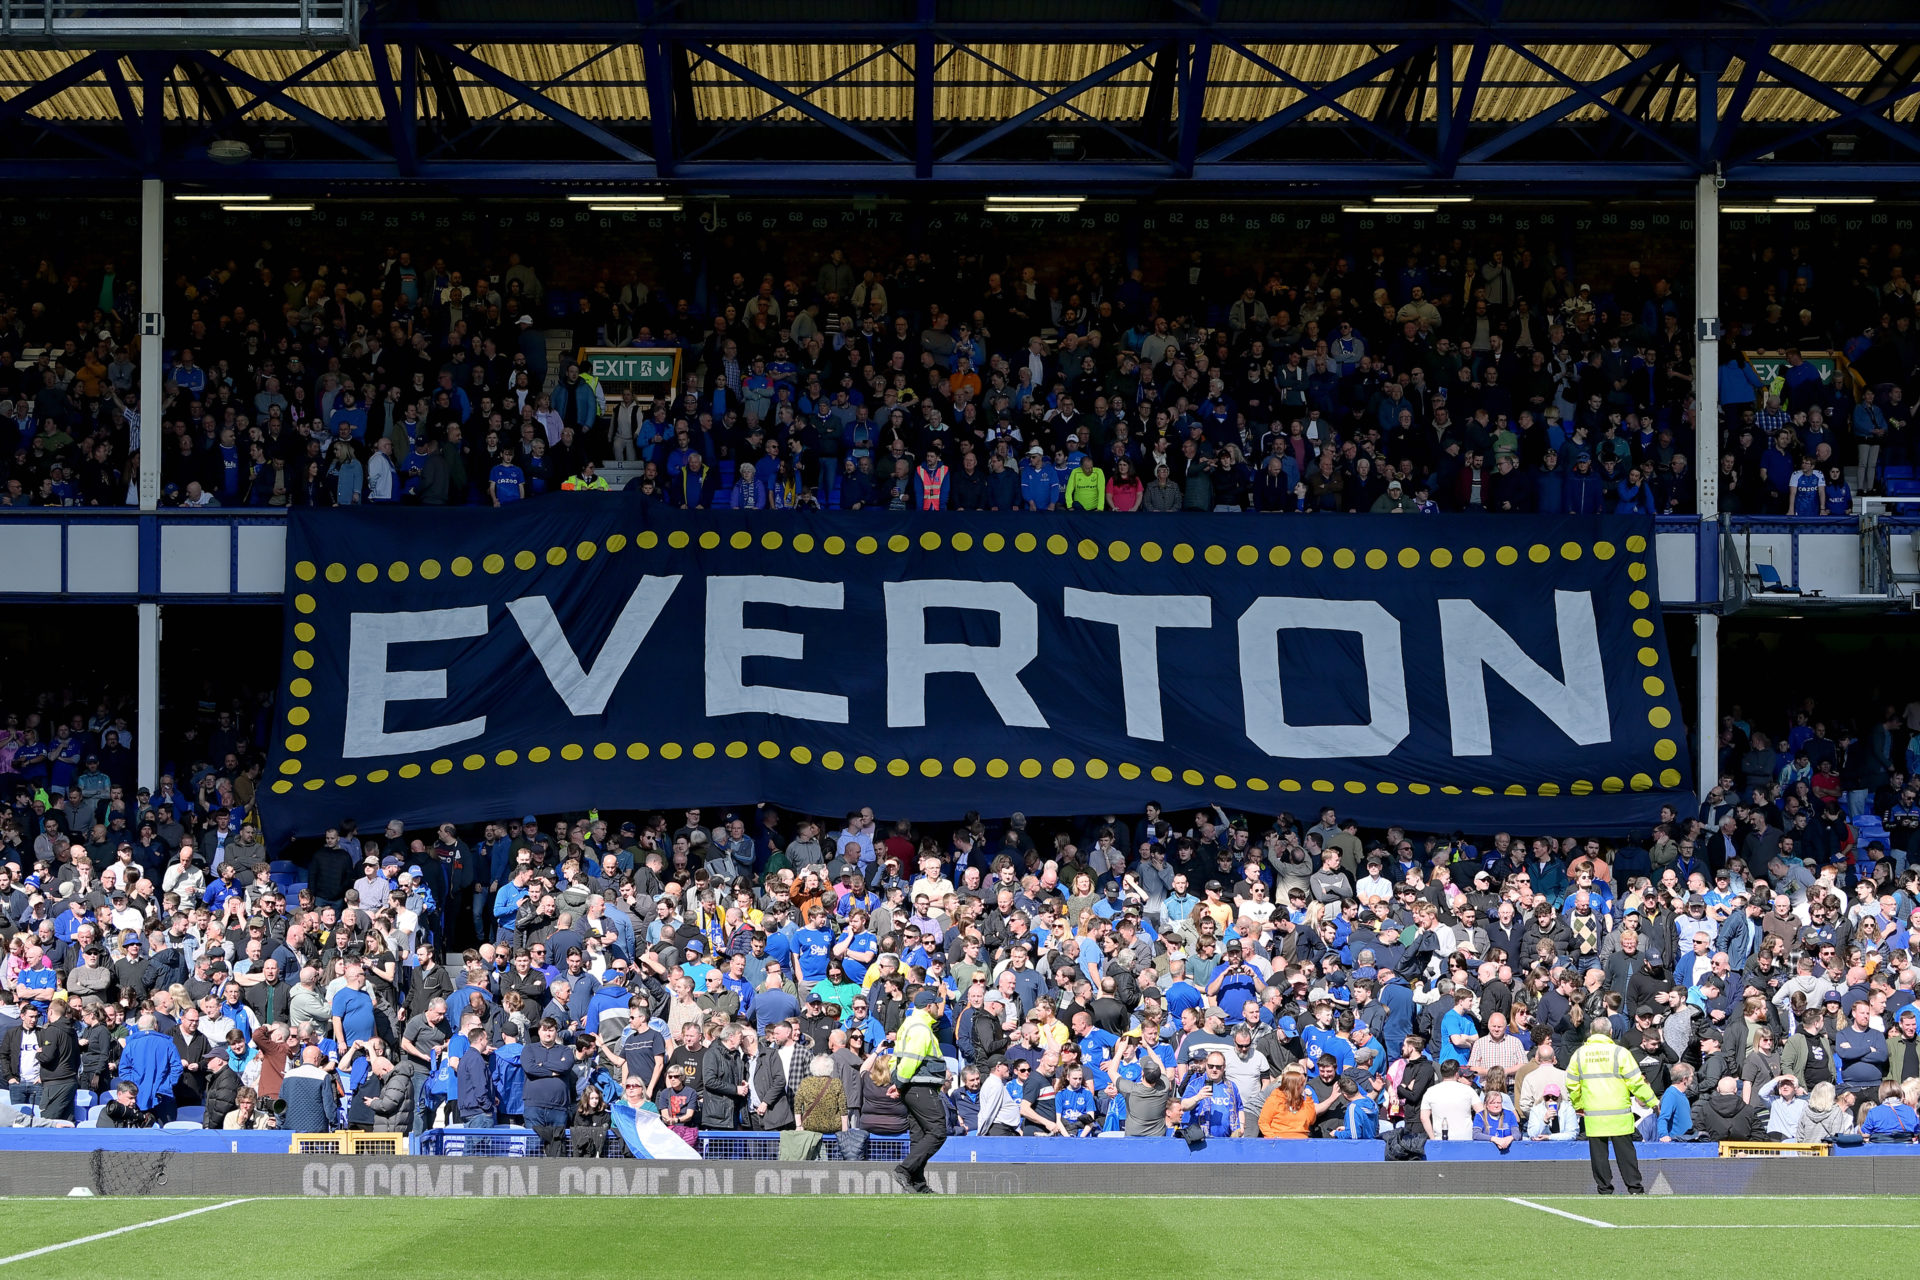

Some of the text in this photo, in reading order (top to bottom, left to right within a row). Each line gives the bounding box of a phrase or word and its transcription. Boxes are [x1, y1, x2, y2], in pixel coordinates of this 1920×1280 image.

[311, 210, 327, 221] 50
[360, 210, 375, 221] 52
[409, 210, 425, 221] 54
[525, 211, 540, 222] 58
[575, 211, 591, 222] 60
[621, 212, 637, 222] 62
[672, 212, 687, 222] 64
[736, 212, 753, 223] 66
[788, 212, 804, 222] 68
[841, 212, 856, 223] 70
[888, 212, 905, 223] 72
[954, 212, 969, 223] 74
[1004, 213, 1019, 223] 76
[1056, 213, 1071, 223] 78
[1104, 212, 1120, 223] 80
[1169, 213, 1184, 223] 82
[1219, 212, 1235, 223] 84
[1270, 213, 1285, 223] 86
[1320, 213, 1336, 223] 88
[1385, 213, 1402, 224] 90
[1435, 213, 1451, 224] 92
[1489, 213, 1504, 224] 94
[1539, 214, 1556, 224] 96
[1601, 214, 1618, 224] 98
[1652, 214, 1671, 224] 100
[1754, 214, 1771, 225] 104
[1820, 214, 1837, 225] 106
[1871, 214, 1888, 225] 108
[287, 216, 303, 227] 49
[336, 216, 348, 227] 51
[384, 217, 399, 227] 53
[435, 217, 451, 227] 55
[498, 216, 513, 227] 57
[549, 217, 565, 227] 59
[599, 217, 612, 228] 61
[648, 217, 664, 228] 63
[762, 218, 777, 228] 67
[811, 218, 828, 229] 69
[865, 218, 879, 229] 71
[928, 218, 943, 229] 73
[1031, 219, 1045, 229] 77
[1080, 218, 1096, 229] 79
[1143, 219, 1156, 229] 81
[1195, 219, 1210, 229] 83
[1245, 219, 1260, 230] 85
[1296, 219, 1312, 230] 87
[1360, 219, 1375, 230] 89
[1414, 219, 1425, 230] 91
[1462, 219, 1477, 230] 93
[1515, 219, 1530, 230] 95
[1576, 219, 1592, 230] 97
[1629, 219, 1646, 230] 99
[1729, 220, 1747, 231] 103
[1793, 220, 1811, 231] 105
[1845, 220, 1863, 231] 107
[1896, 220, 1913, 231] 109
[141, 313, 158, 334] H
[592, 360, 637, 377] EXIT
[343, 573, 1612, 759] EVERTON
[1210, 1098, 1229, 1106] NEC
[302, 1163, 356, 1196] SO
[364, 1163, 474, 1196] COME
[483, 1165, 539, 1196] ON
[559, 1166, 669, 1195] COME
[679, 1167, 733, 1195] ON
